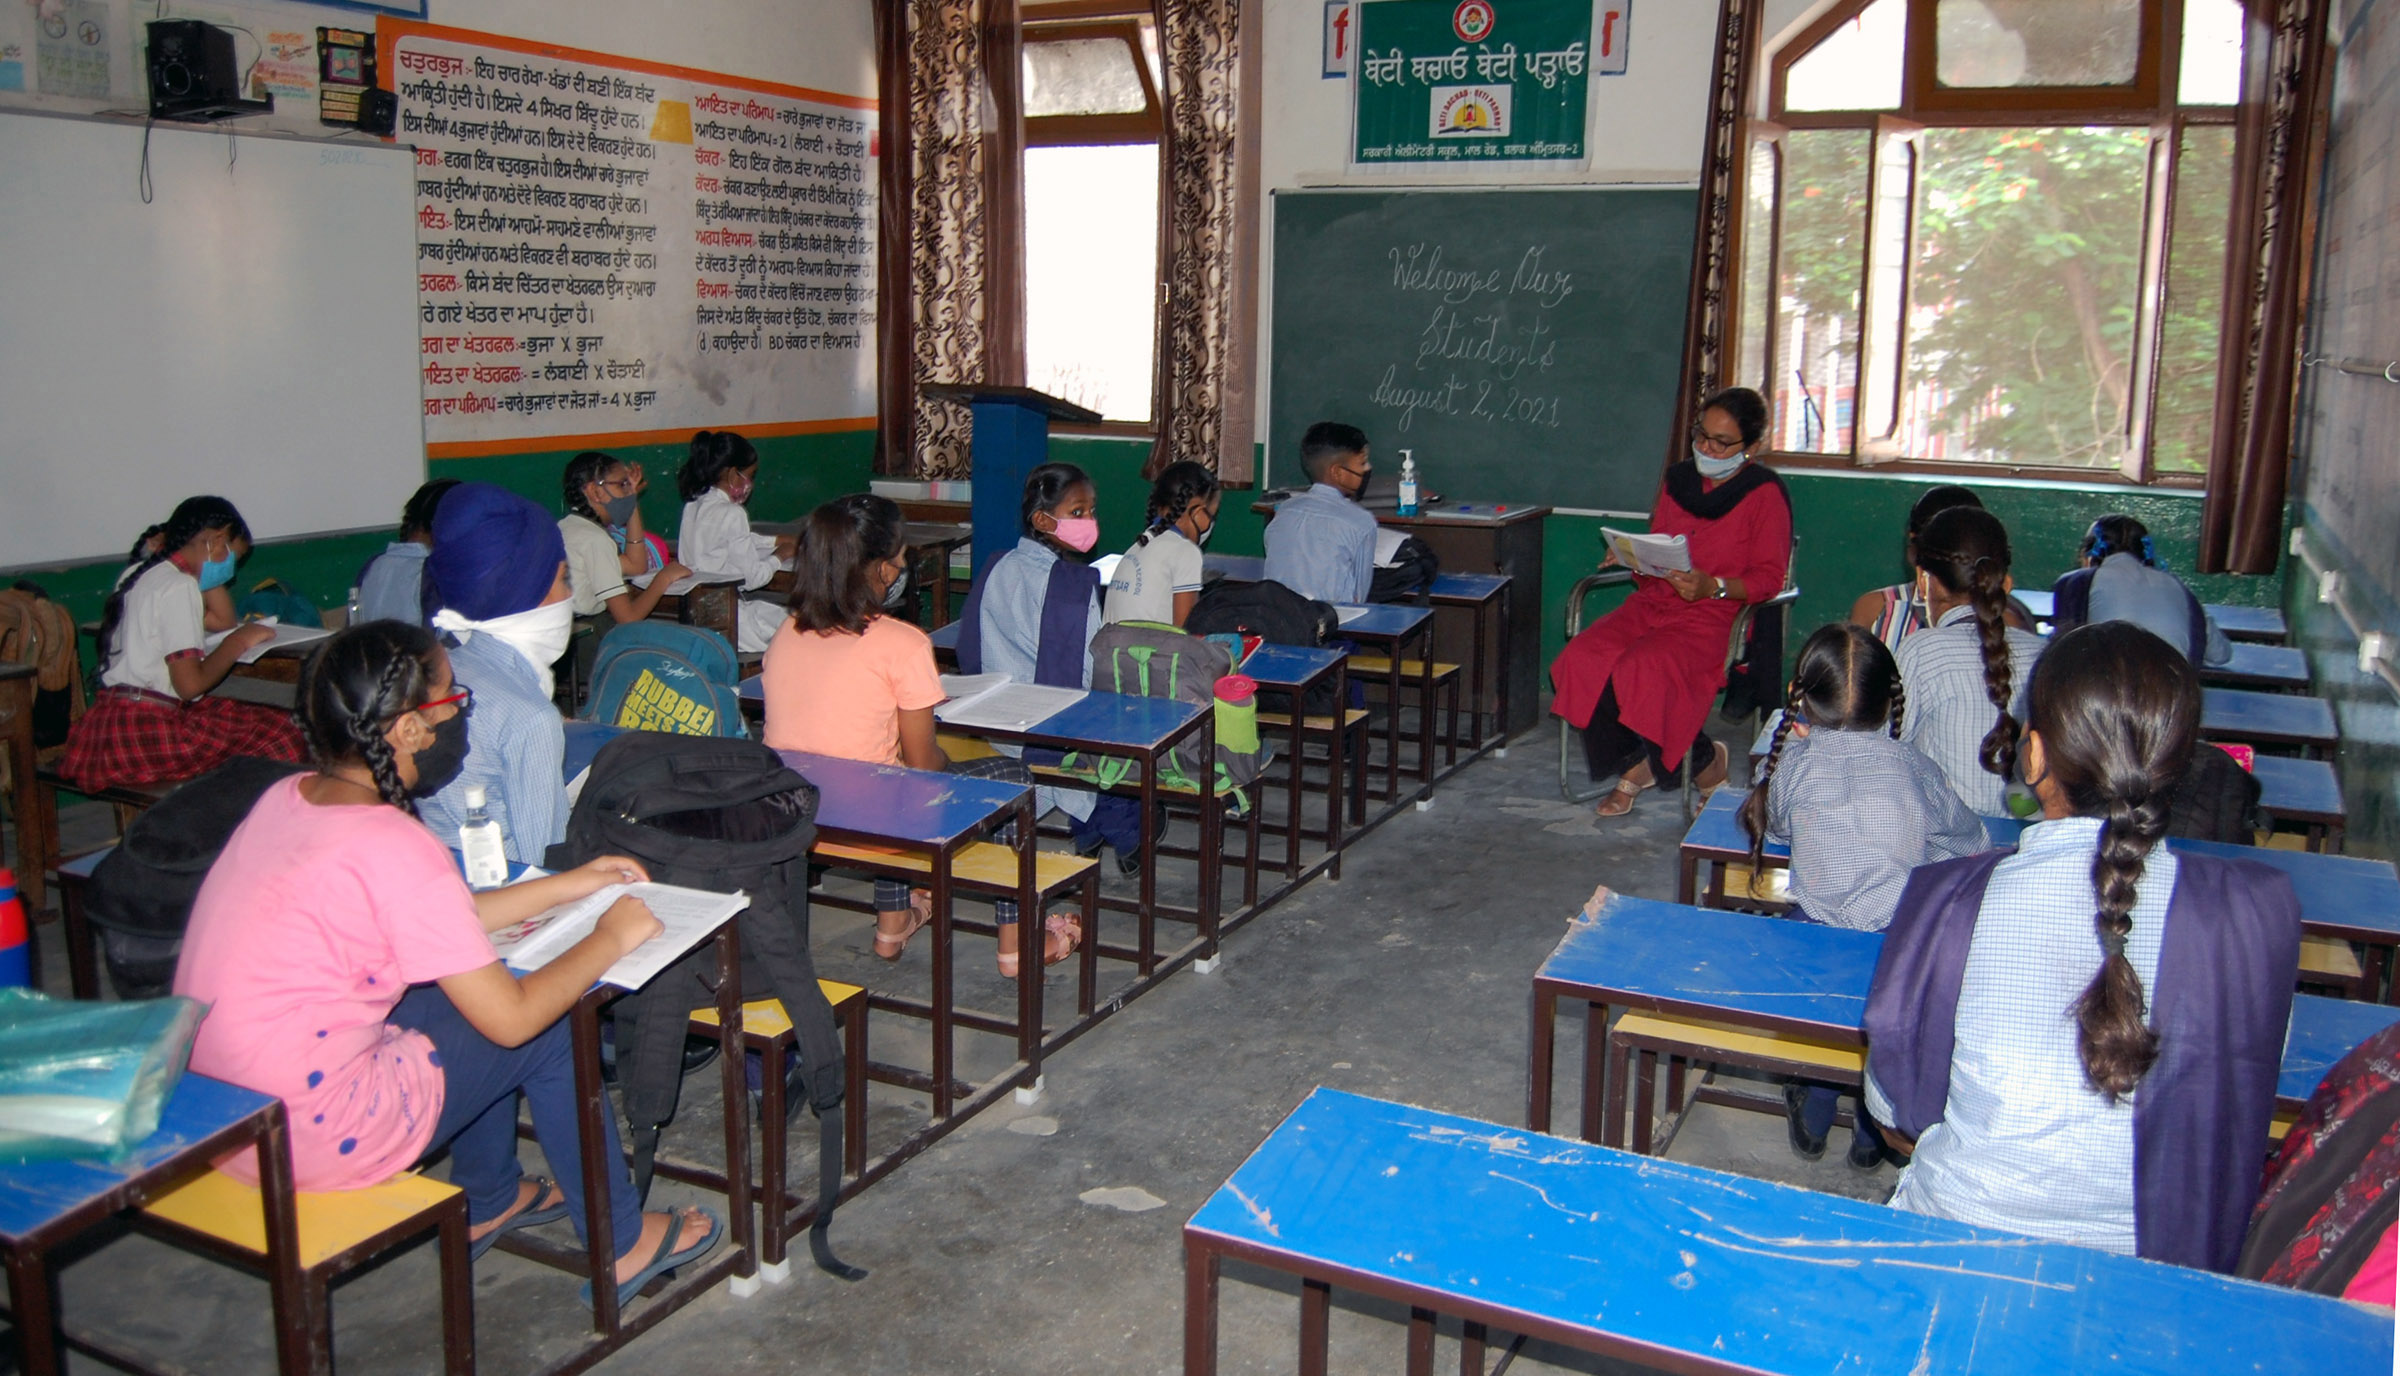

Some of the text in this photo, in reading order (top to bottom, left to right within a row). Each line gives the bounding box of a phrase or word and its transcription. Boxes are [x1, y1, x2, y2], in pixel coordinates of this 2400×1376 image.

[474, 56, 495, 80] ਇਹ
[498, 65, 520, 83] ਚਾਰ
[573, 71, 585, 93] ਦੀ
[613, 78, 633, 100] ਇੱਕ
[635, 83, 655, 103] ਬੰਦ
[1364, 42, 1585, 88] ਬੇਟੀ ਬਚਾਓ ਬੇਟੀ ਪੜ੍ਹਾਓ
[449, 84, 472, 110] ਹੁੰਦੀ
[526, 100, 537, 116] 4
[540, 97, 572, 120] ਸਿਖਰ
[575, 101, 598, 130] ਬਿੰਦੂ
[601, 106, 618, 130] ਹੁੰਦੇ
[695, 93, 728, 115] ਆਇਤ
[729, 102, 741, 116] ਦਾ
[742, 99, 775, 121] ਪਰਿਮਾਪ
[783, 107, 798, 125] ਚਾਰੇ
[826, 117, 836, 130] ਦਾ
[403, 109, 423, 134] ਇਸ
[424, 112, 448, 136] ਦੀਆਂ
[587, 132, 620, 156] ਵਿਕਰਣ
[695, 121, 726, 140] ਆਇਤ
[728, 128, 738, 142] ਦਾ
[739, 125, 771, 147] ਪਰਿਮਾਪ
[444, 152, 472, 170] ਵਰਗ
[475, 149, 495, 172] ਇੱਕ
[497, 157, 540, 178] ਚਤੁਰਭੁਜ
[554, 158, 571, 179] ਇਸ
[599, 163, 615, 182] ਚਾਰੇ
[729, 149, 747, 169] ਇਹ
[773, 155, 793, 175] ਗੋਲ
[795, 159, 811, 176] ਬੰਦ
[482, 185, 498, 202] ਹਨ
[499, 183, 516, 203] ਅਤੇ
[533, 184, 566, 207] ਵਿਕਰਣ
[569, 192, 607, 211] ਬਰਾਬਰ
[454, 208, 476, 231] ਇਸ
[482, 246, 498, 261] ਹਨ
[500, 243, 519, 263] ਅਤੇ
[520, 242, 554, 264] ਵਿਕਰਣ
[556, 243, 568, 265] ਵੀ
[571, 250, 611, 267] ਬਰਾਬਰ
[465, 269, 656, 300] ਕਿਸੇ ਬੰਦ ਚਿੱਤਰ ਦਾ ਖੇਤਰਫਲ ਉਸ ਦੁਆਰਾ
[1389, 243, 1573, 308] Welcome Our
[437, 301, 574, 327] ਗਏ ਖੇਤਰ ਦਾ ਮਾਪ ਹੁੰਦਾ
[445, 337, 460, 353] ਦਾ
[527, 337, 555, 356] ਭੁਜਾ
[576, 336, 603, 356] ਭੁਜਾ
[811, 336, 820, 350] ਦਾ
[823, 331, 852, 350] ਵਿਆਸ
[1416, 305, 1556, 380] Students
[455, 367, 470, 383] ਦਾ
[544, 359, 588, 380] ਲੰਬਾਈ
[607, 359, 645, 380] ਚੌੜਾਈ
[443, 398, 457, 414] ਦਾ
[459, 391, 496, 413] ਪਰਿਮਾਪ
[558, 394, 569, 410] ਦਾ
[570, 389, 587, 409] ਜੋੜ
[633, 391, 656, 411] ਭੁਜਾ
[1369, 364, 1467, 432] August
[1503, 386, 1560, 428] 2021
[625, 691, 675, 733] MEETS
